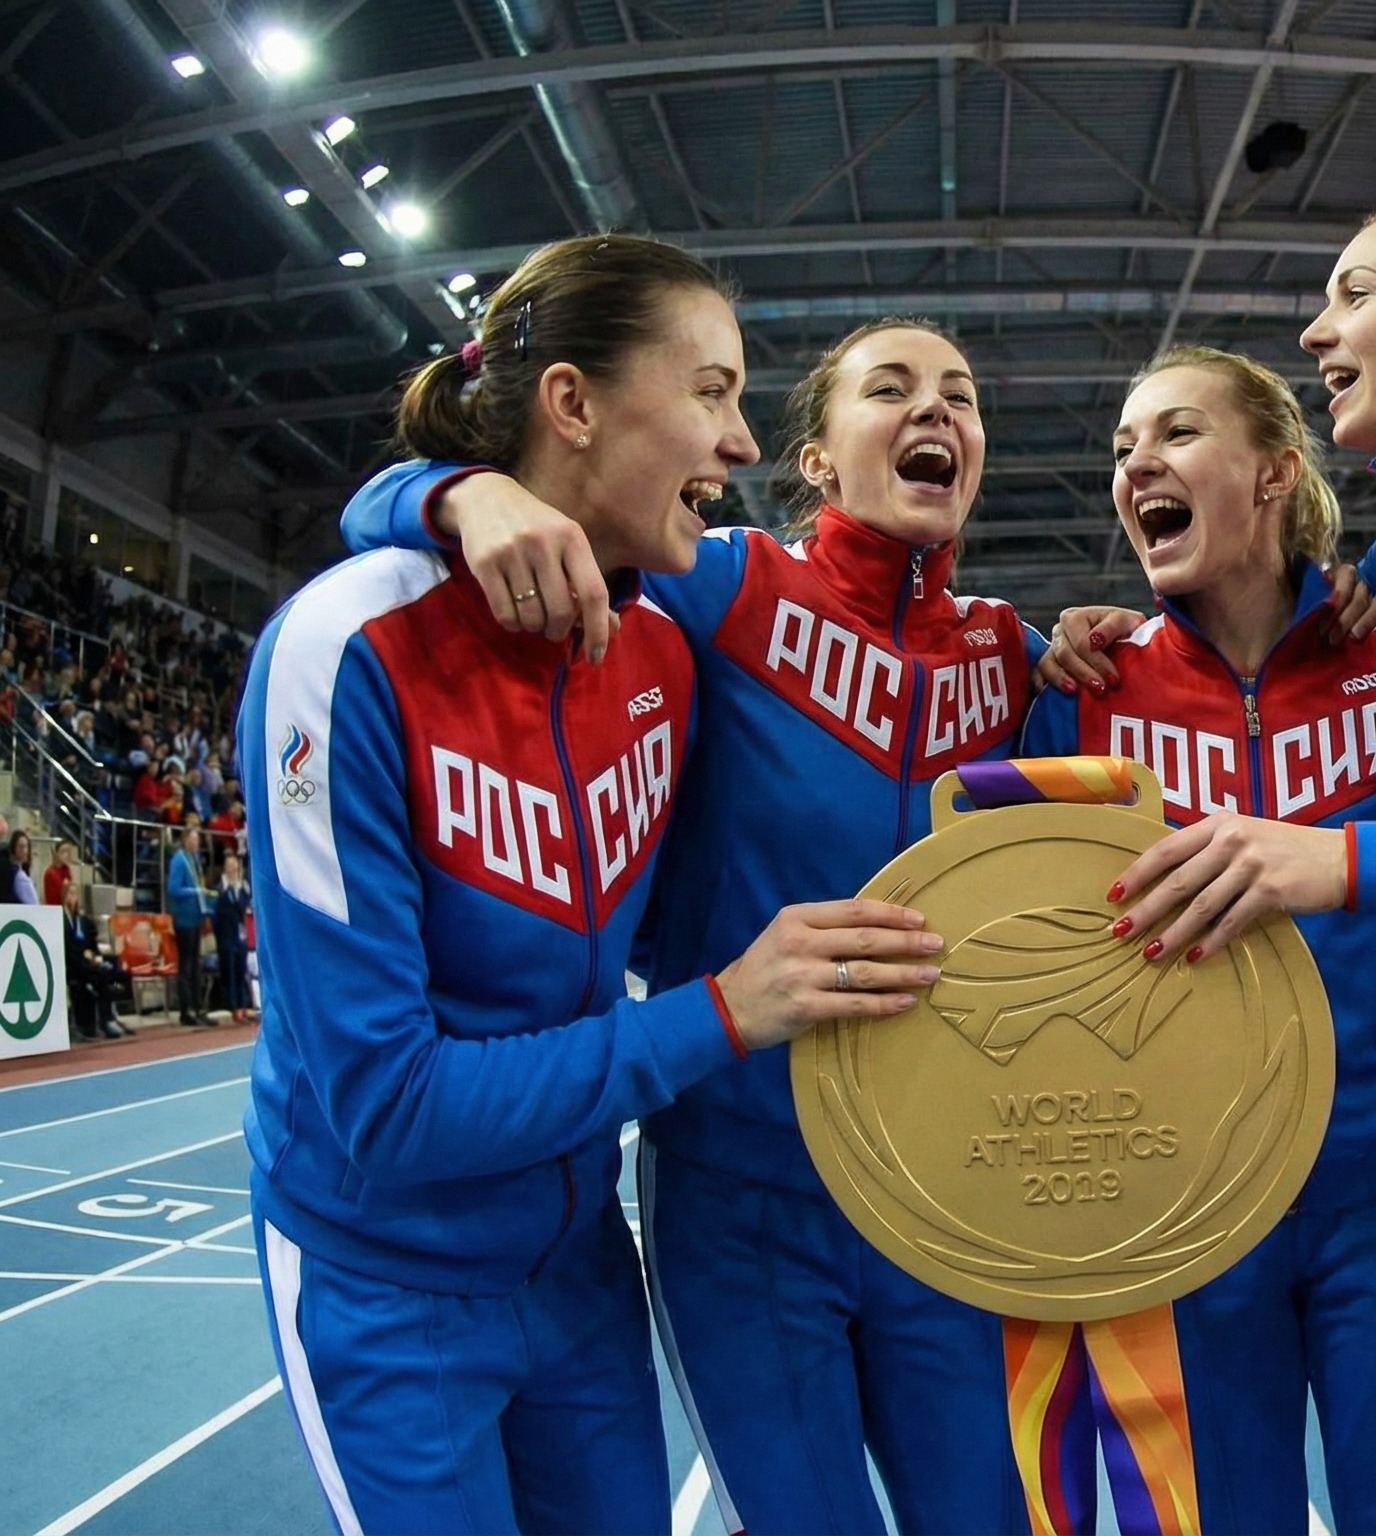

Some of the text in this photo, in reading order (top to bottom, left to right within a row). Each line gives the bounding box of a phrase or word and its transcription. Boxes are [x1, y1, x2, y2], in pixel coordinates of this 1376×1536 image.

[990, 1088, 1142, 1127] WORLD
[963, 1125, 1180, 1168] ATHLETICS
[1020, 1168, 1123, 1206] 2019
[77, 1193, 215, 1223] 5
